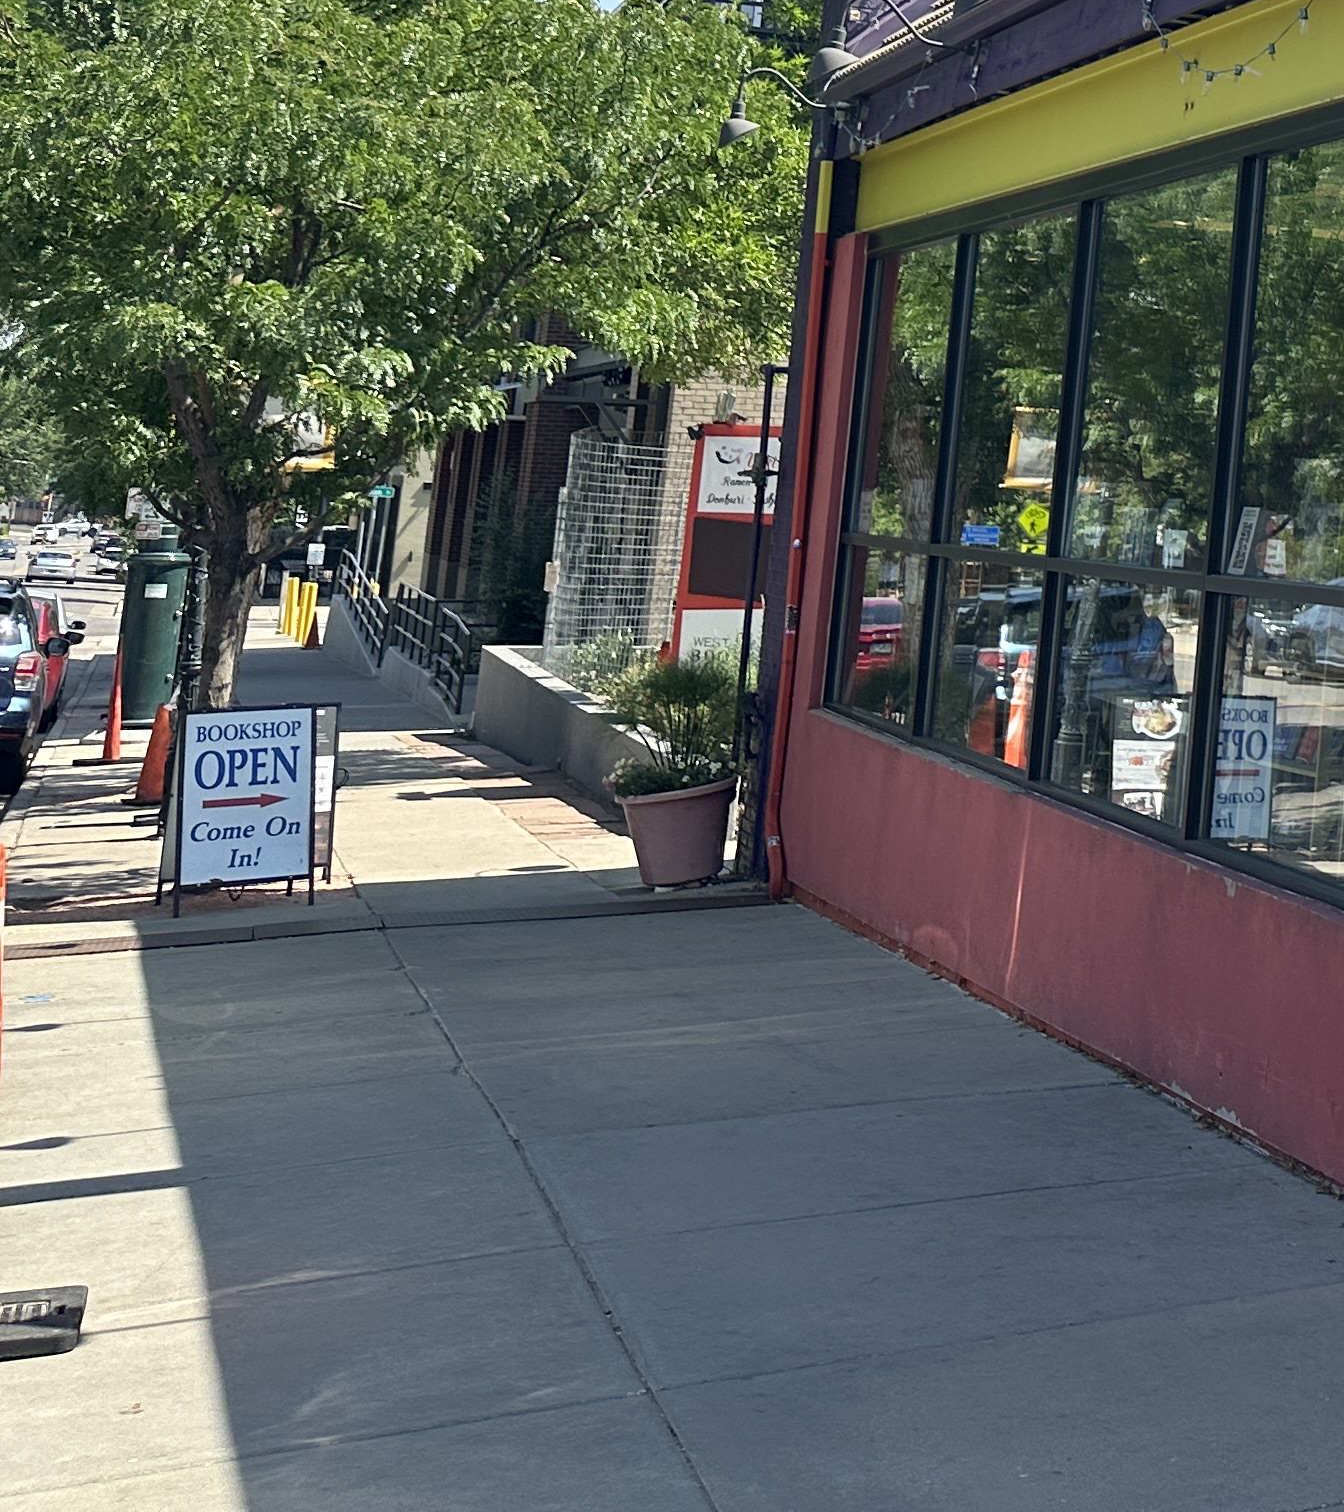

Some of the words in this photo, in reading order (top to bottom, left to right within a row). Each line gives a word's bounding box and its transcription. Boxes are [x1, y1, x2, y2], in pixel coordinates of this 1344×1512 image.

[693, 636, 730, 648] WEST
[196, 720, 302, 743] BOOKSHOP
[194, 746, 300, 790] OPEN
[190, 821, 256, 843] Come
[265, 816, 301, 837] On
[228, 847, 262, 869] In!
